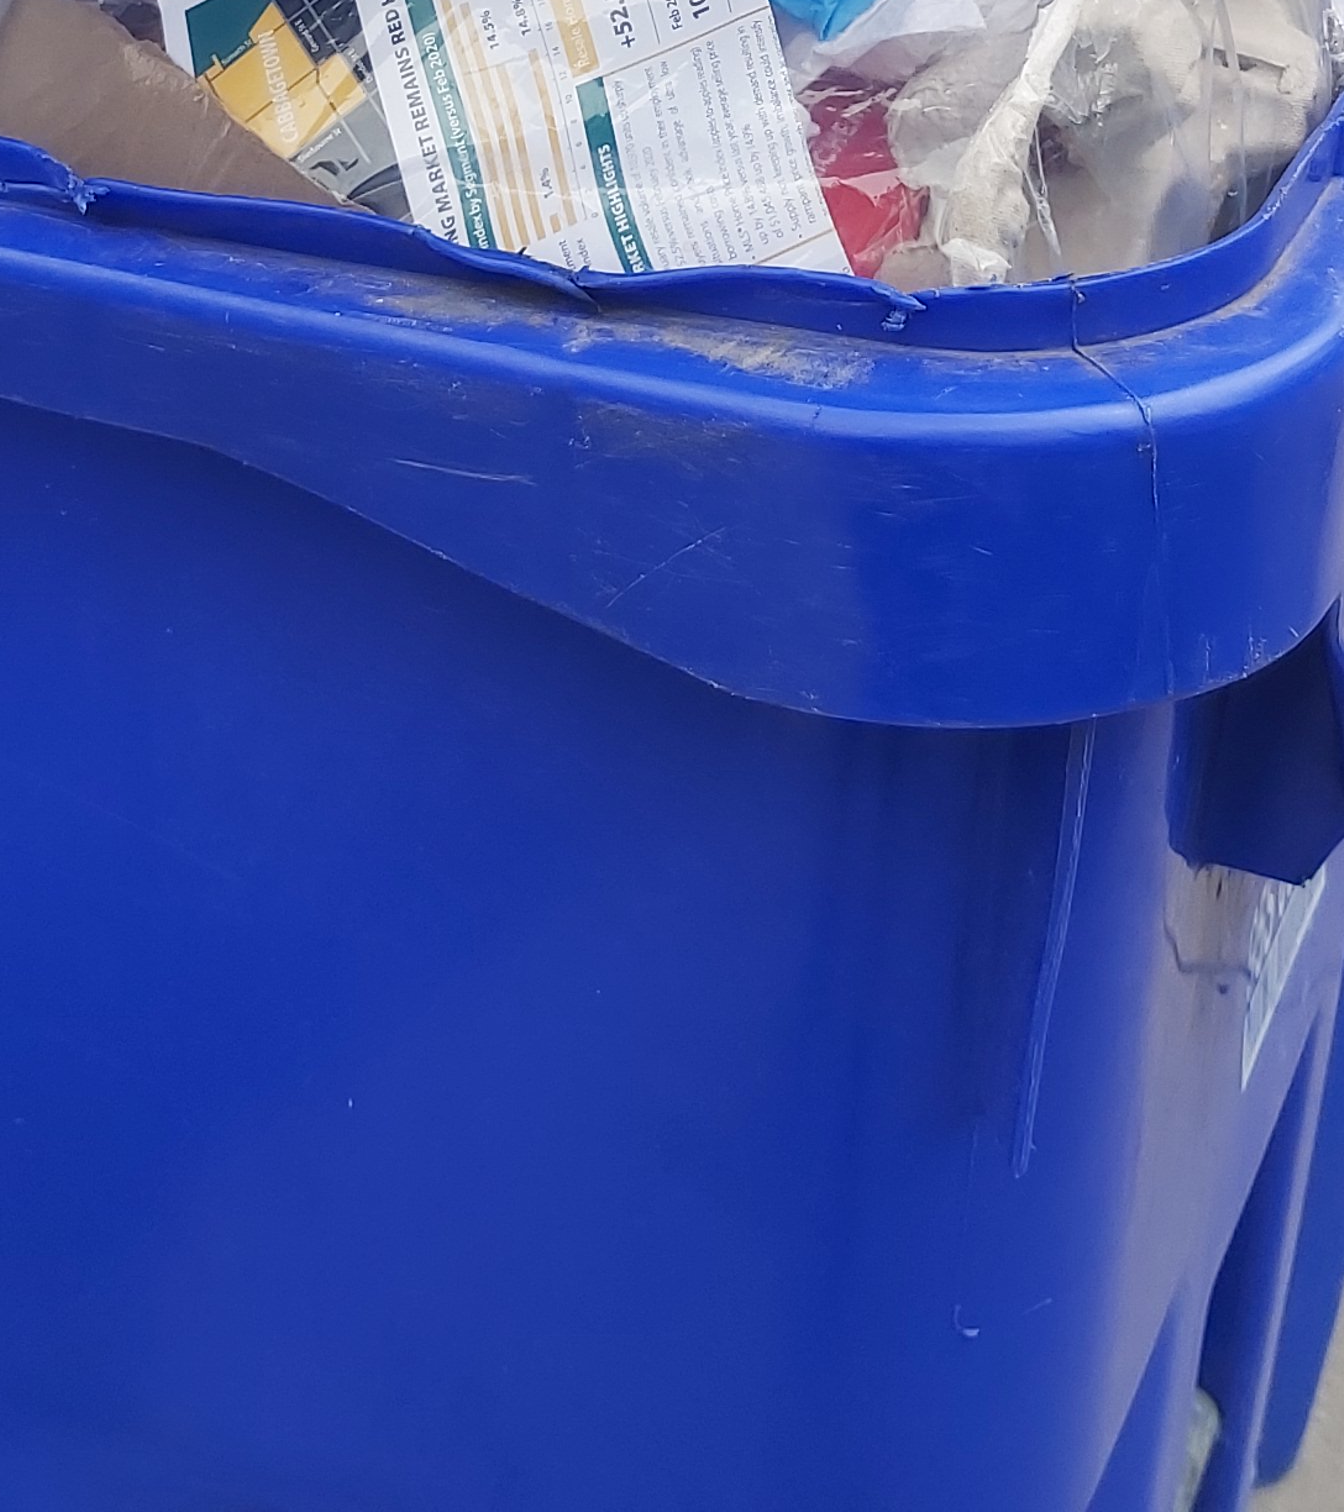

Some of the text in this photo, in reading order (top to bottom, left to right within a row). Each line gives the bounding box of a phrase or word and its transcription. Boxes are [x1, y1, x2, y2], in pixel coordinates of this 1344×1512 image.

[383, 7, 406, 45] RED
[478, 9, 500, 49] 14.5%
[667, 8, 683, 30] Feb
[421, 31, 444, 68] 2020)
[256, 29, 299, 142] CABBAGETOWN
[393, 45, 430, 131] REMAINS
[431, 68, 449, 93] Feb
[417, 133, 452, 213] MARKET
[596, 143, 630, 232] HIGHLIGHTS
[440, 214, 459, 243] NG
[558, 239, 575, 270] ment
[574, 237, 591, 266] ndex
